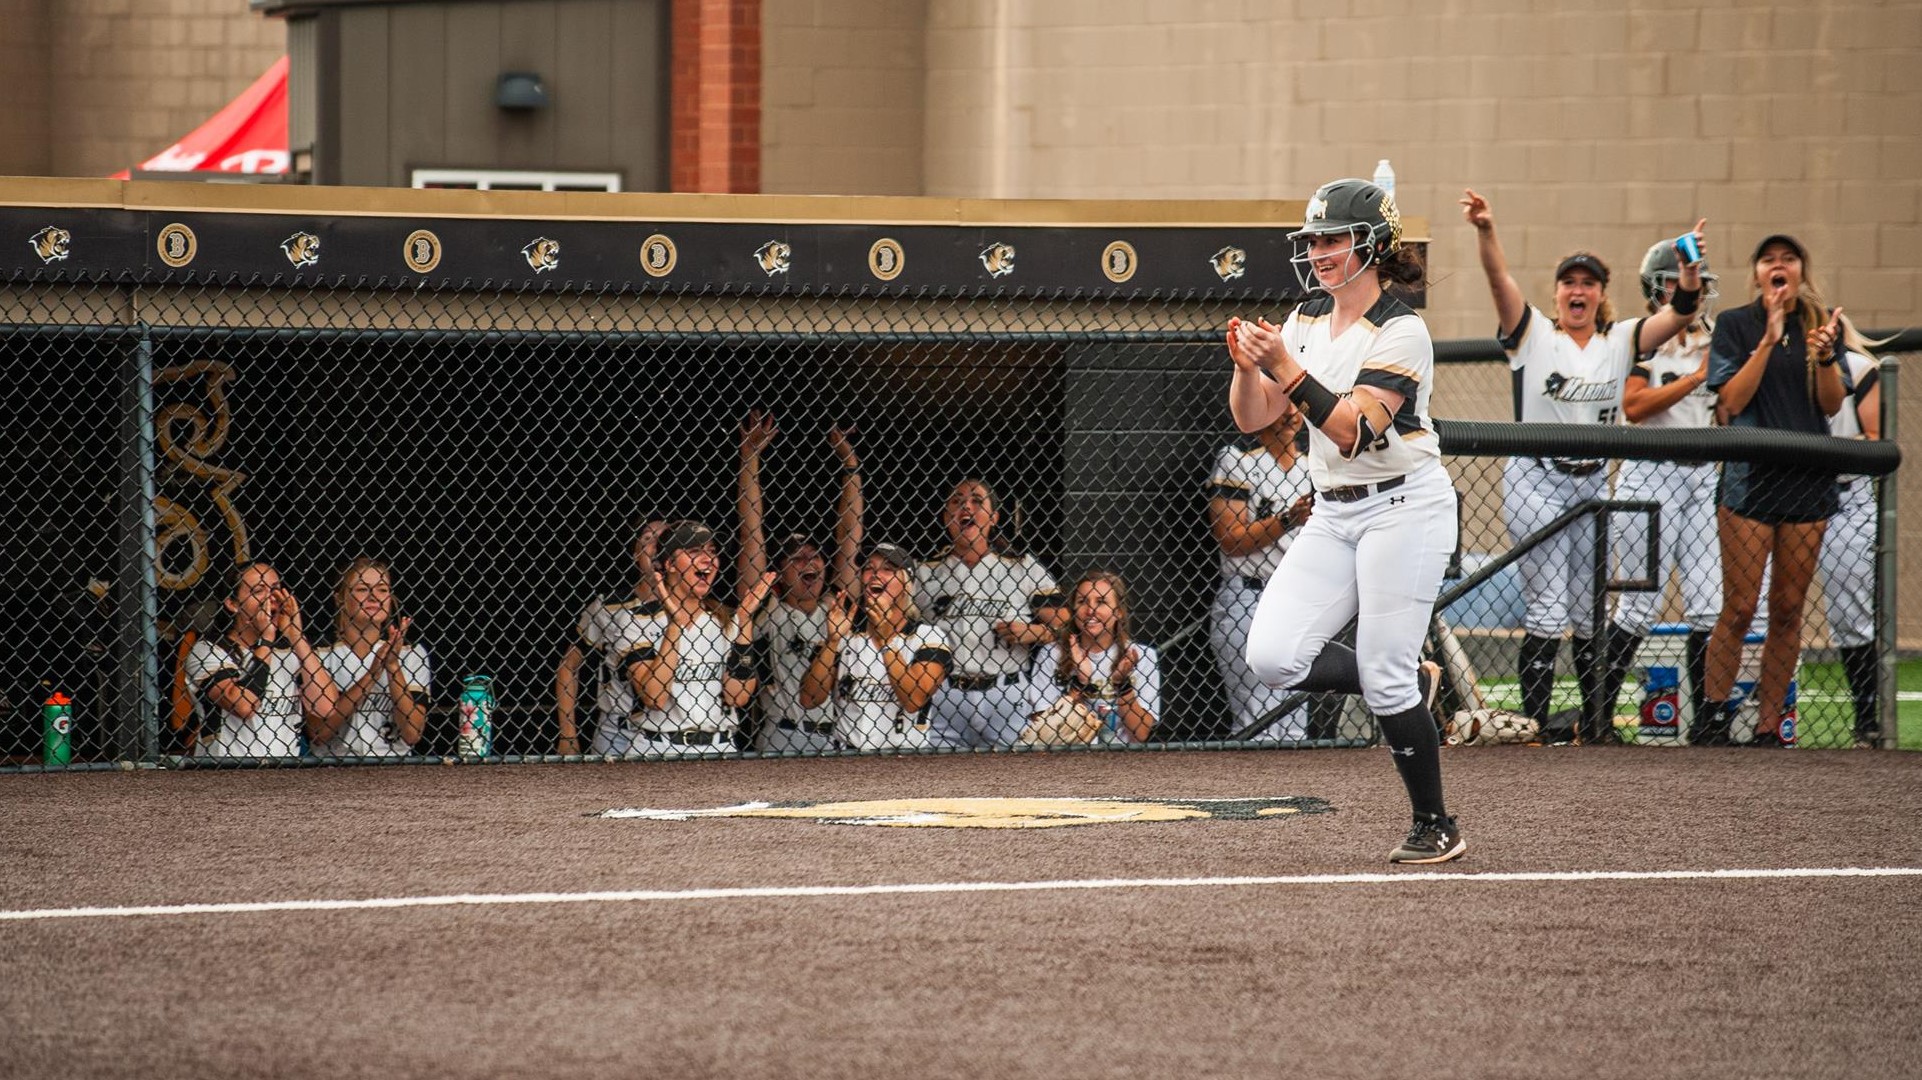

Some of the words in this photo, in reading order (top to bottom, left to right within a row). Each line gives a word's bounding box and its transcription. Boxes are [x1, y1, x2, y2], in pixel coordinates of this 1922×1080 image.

[169, 232, 185, 257] B
[415, 239, 430, 264] B
[651, 243, 666, 268] B
